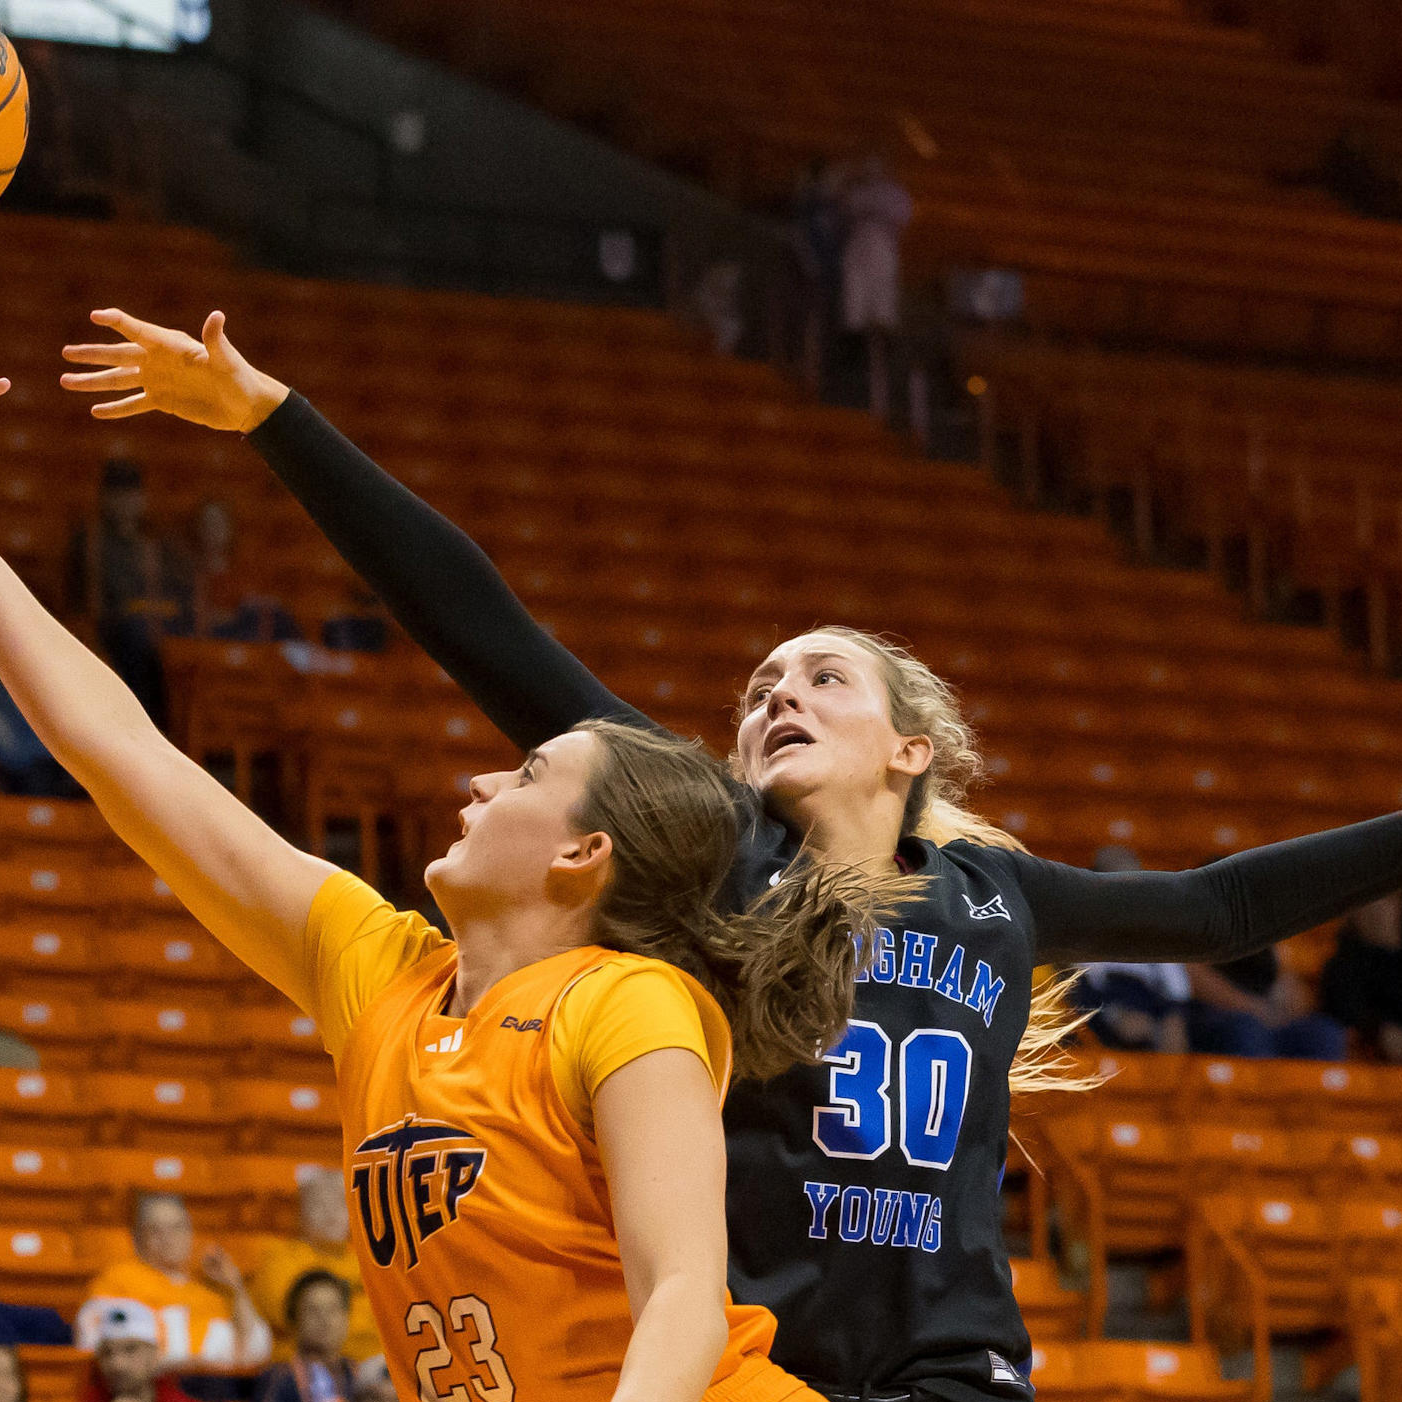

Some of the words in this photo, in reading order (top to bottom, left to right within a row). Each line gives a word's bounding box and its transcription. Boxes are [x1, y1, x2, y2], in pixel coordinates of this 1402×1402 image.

[847, 927, 1006, 1029] IGHAM
[812, 1018, 973, 1172] 30
[351, 1112, 488, 1274] UTEP
[803, 1181, 943, 1254] YOUNG
